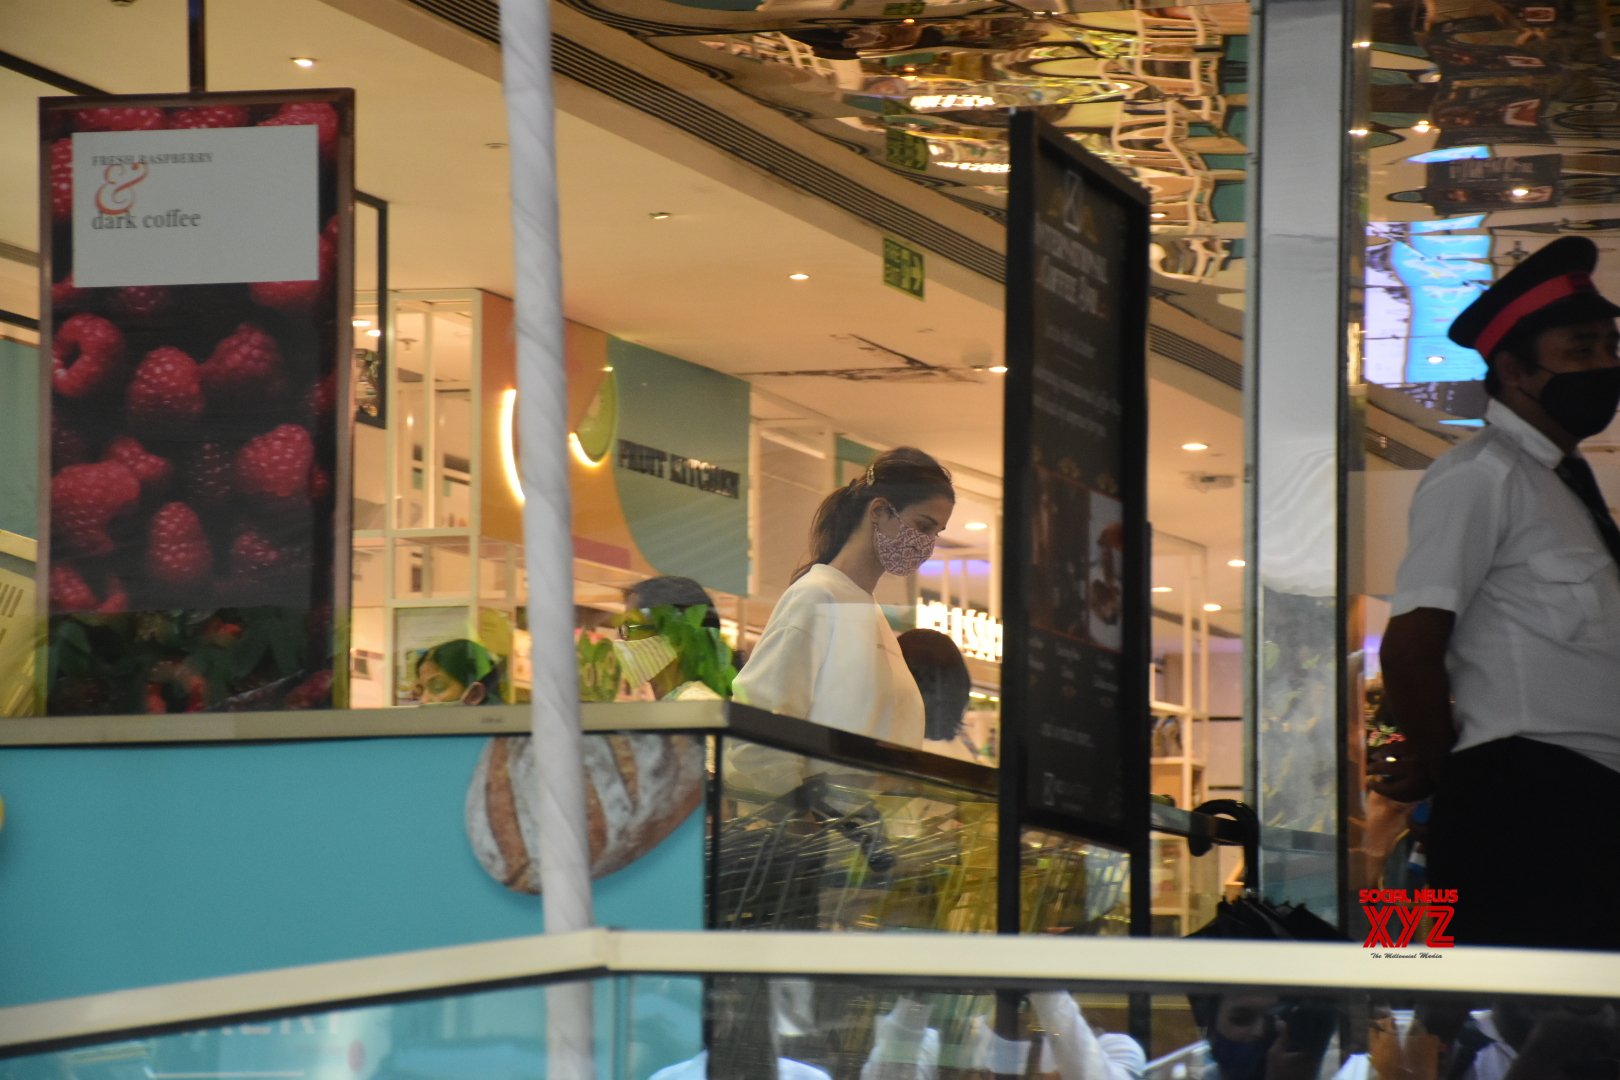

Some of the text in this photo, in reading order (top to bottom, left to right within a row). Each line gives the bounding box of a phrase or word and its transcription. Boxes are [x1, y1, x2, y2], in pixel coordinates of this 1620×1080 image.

[138, 152, 214, 164] RASPBERRY
[95, 161, 149, 215] &
[92, 208, 202, 229] dark coffee
[618, 438, 741, 500] FRUIT KITCHEN
